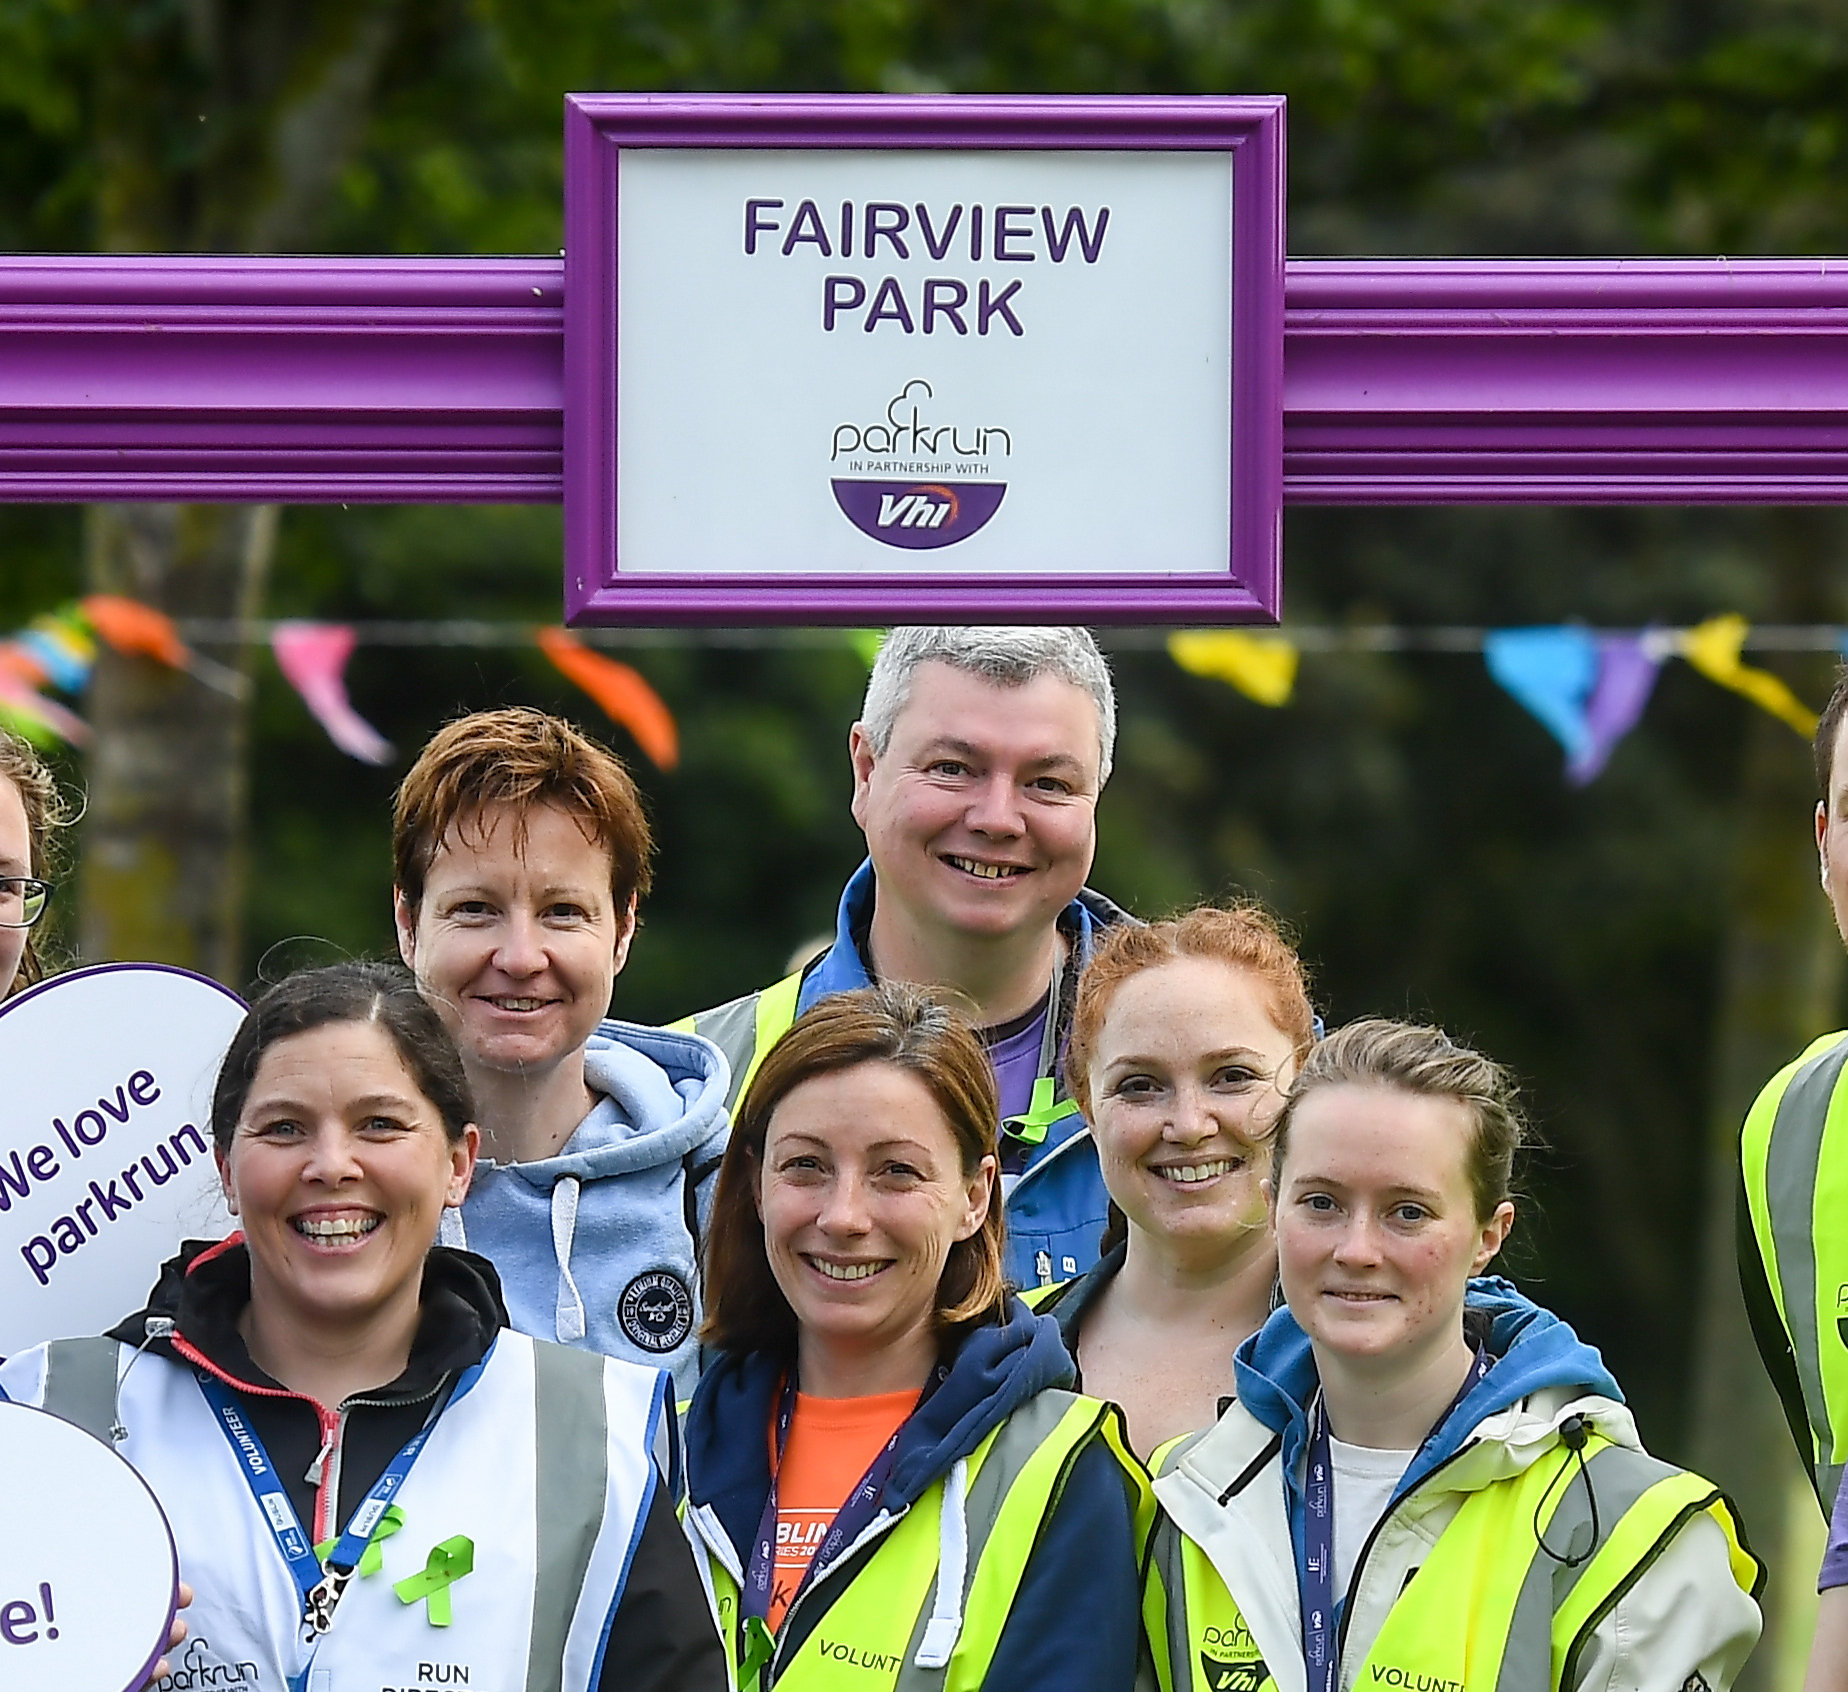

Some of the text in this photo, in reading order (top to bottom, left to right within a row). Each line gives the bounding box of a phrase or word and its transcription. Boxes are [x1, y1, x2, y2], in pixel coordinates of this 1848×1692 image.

[744, 199, 1110, 263] FAIRVIEW
[823, 275, 1024, 336] PARK
[831, 379, 1010, 461] parkrun
[850, 461, 989, 474] IN PARTNERSHIP WITH
[877, 493, 951, 528] Vhi
[53, 1070, 161, 1159] love
[21, 1124, 208, 1286] parkrun
[222, 1406, 268, 1476] VOLUNTEER
[418, 1662, 469, 1684] RUN
